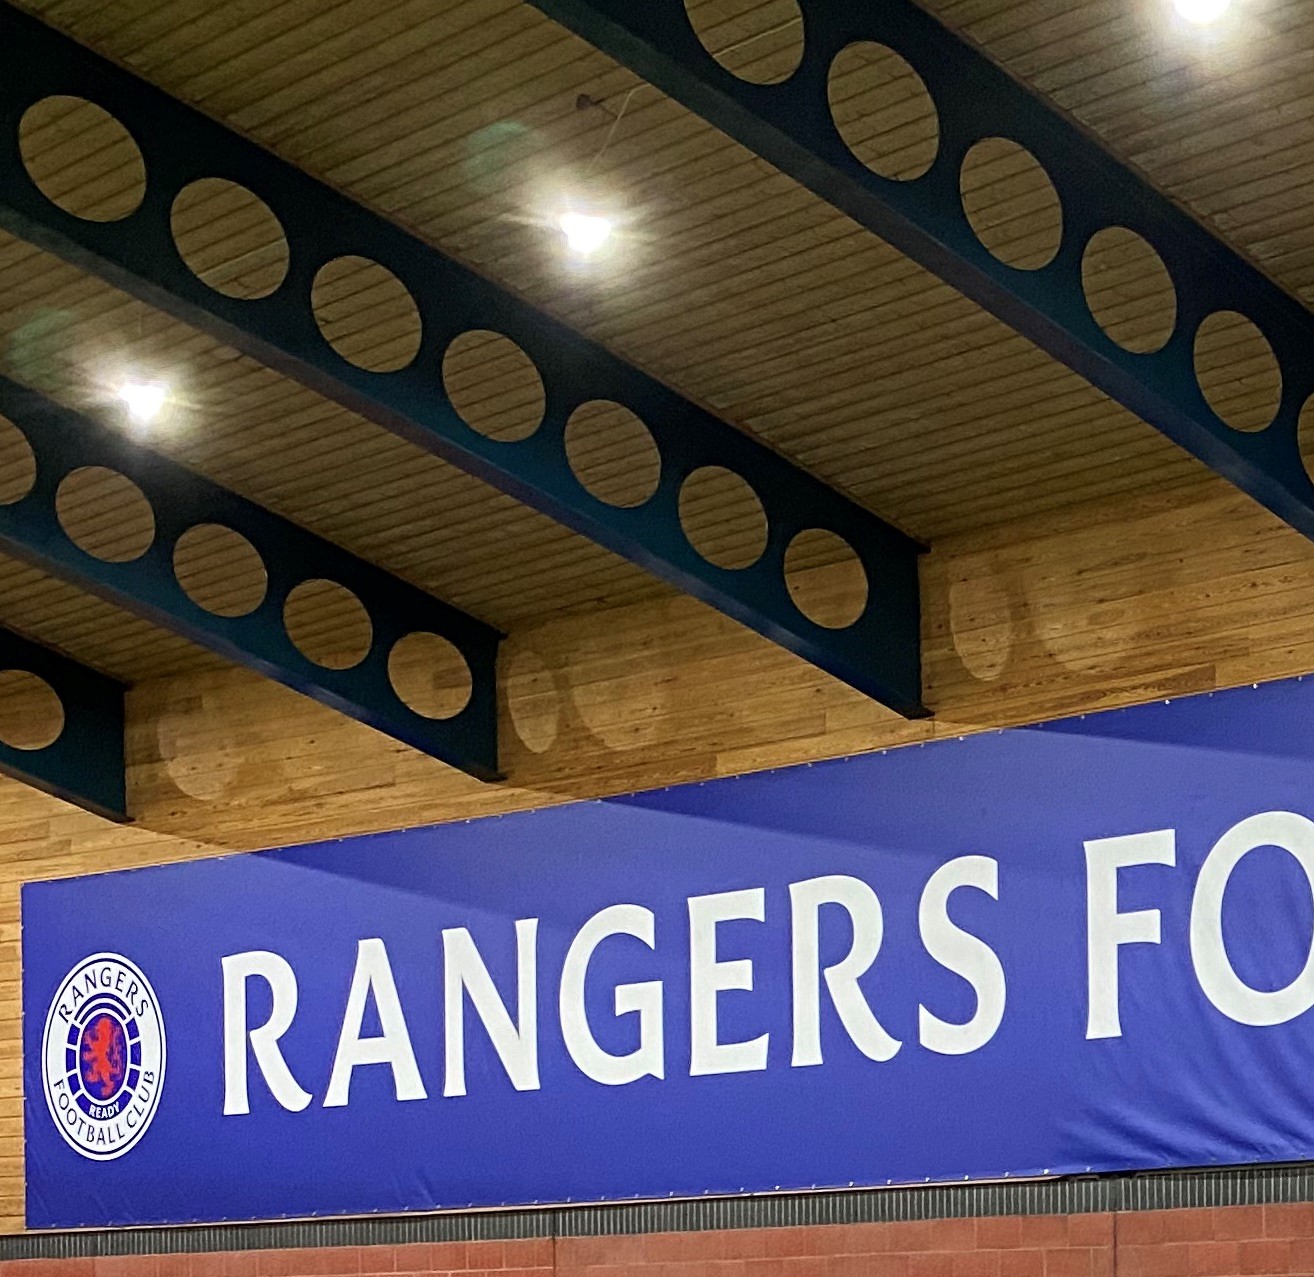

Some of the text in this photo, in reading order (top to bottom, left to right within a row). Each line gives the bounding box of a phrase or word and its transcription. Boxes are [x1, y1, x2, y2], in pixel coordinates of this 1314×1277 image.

[58, 967, 148, 1023] RANGERS
[221, 854, 1006, 1116] RANGERS
[53, 1070, 155, 1145] FOOTBALL CLUB
[89, 1102, 120, 1119] READY
